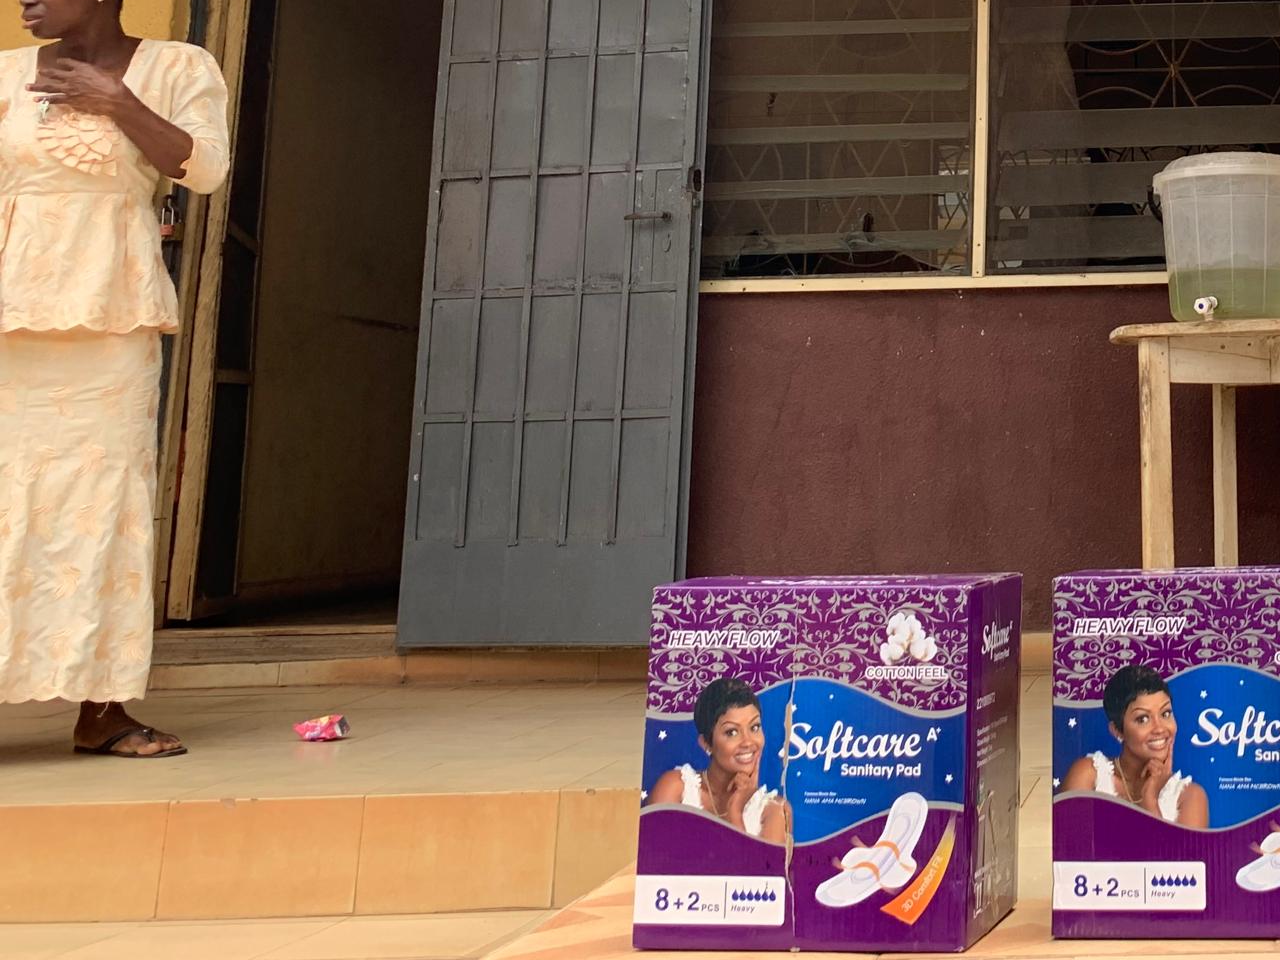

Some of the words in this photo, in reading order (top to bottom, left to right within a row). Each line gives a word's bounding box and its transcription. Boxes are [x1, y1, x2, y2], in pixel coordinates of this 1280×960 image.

[1073, 617, 1133, 636] HEAVY
[1134, 616, 1187, 635] FLOW
[668, 630, 727, 648] HEAVY
[728, 630, 780, 648] FLOW
[865, 666, 915, 680] COTTON
[916, 665, 949, 680] FEEL
[778, 720, 922, 771] Softcare
[841, 763, 894, 779] Sanitary
[896, 763, 921, 776] Pad
[1151, 890, 1176, 898] Heavy
[701, 904, 720, 912] PCS
[731, 905, 755, 913] Heavy
[902, 899, 913, 912] 3D
